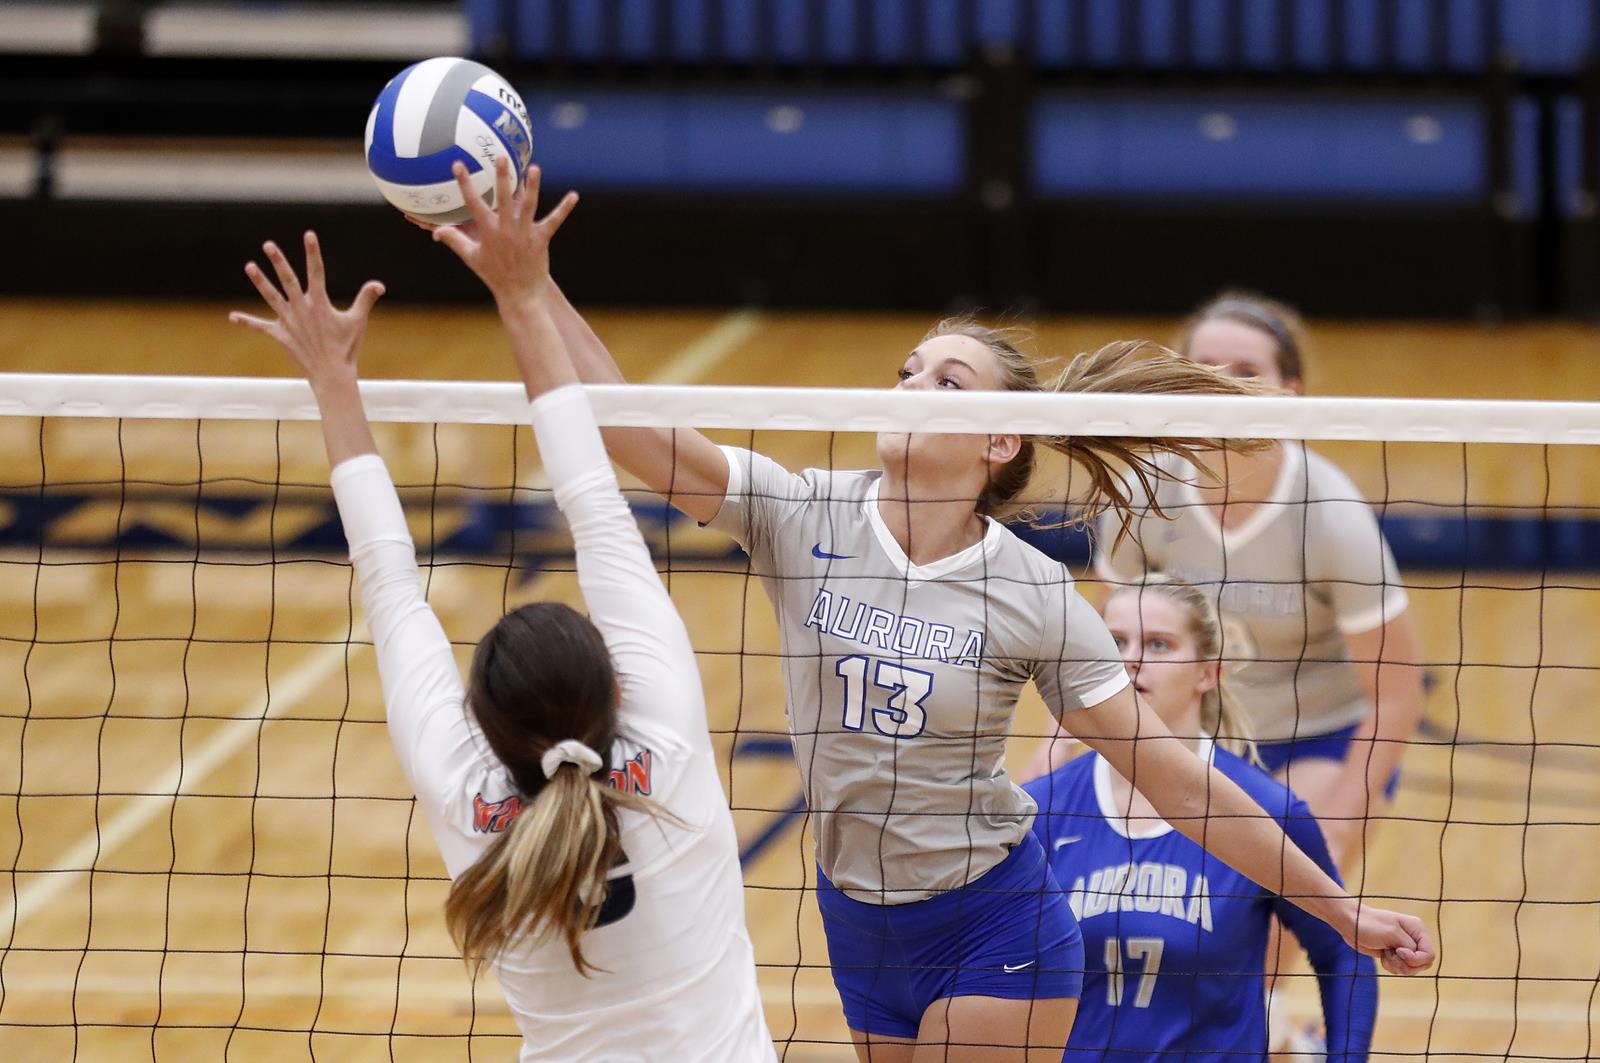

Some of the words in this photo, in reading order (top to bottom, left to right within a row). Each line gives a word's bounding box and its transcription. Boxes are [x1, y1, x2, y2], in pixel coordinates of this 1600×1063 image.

[804, 588, 984, 669] AURORA
[836, 654, 934, 739] 13
[1104, 936, 1165, 1009] 17
